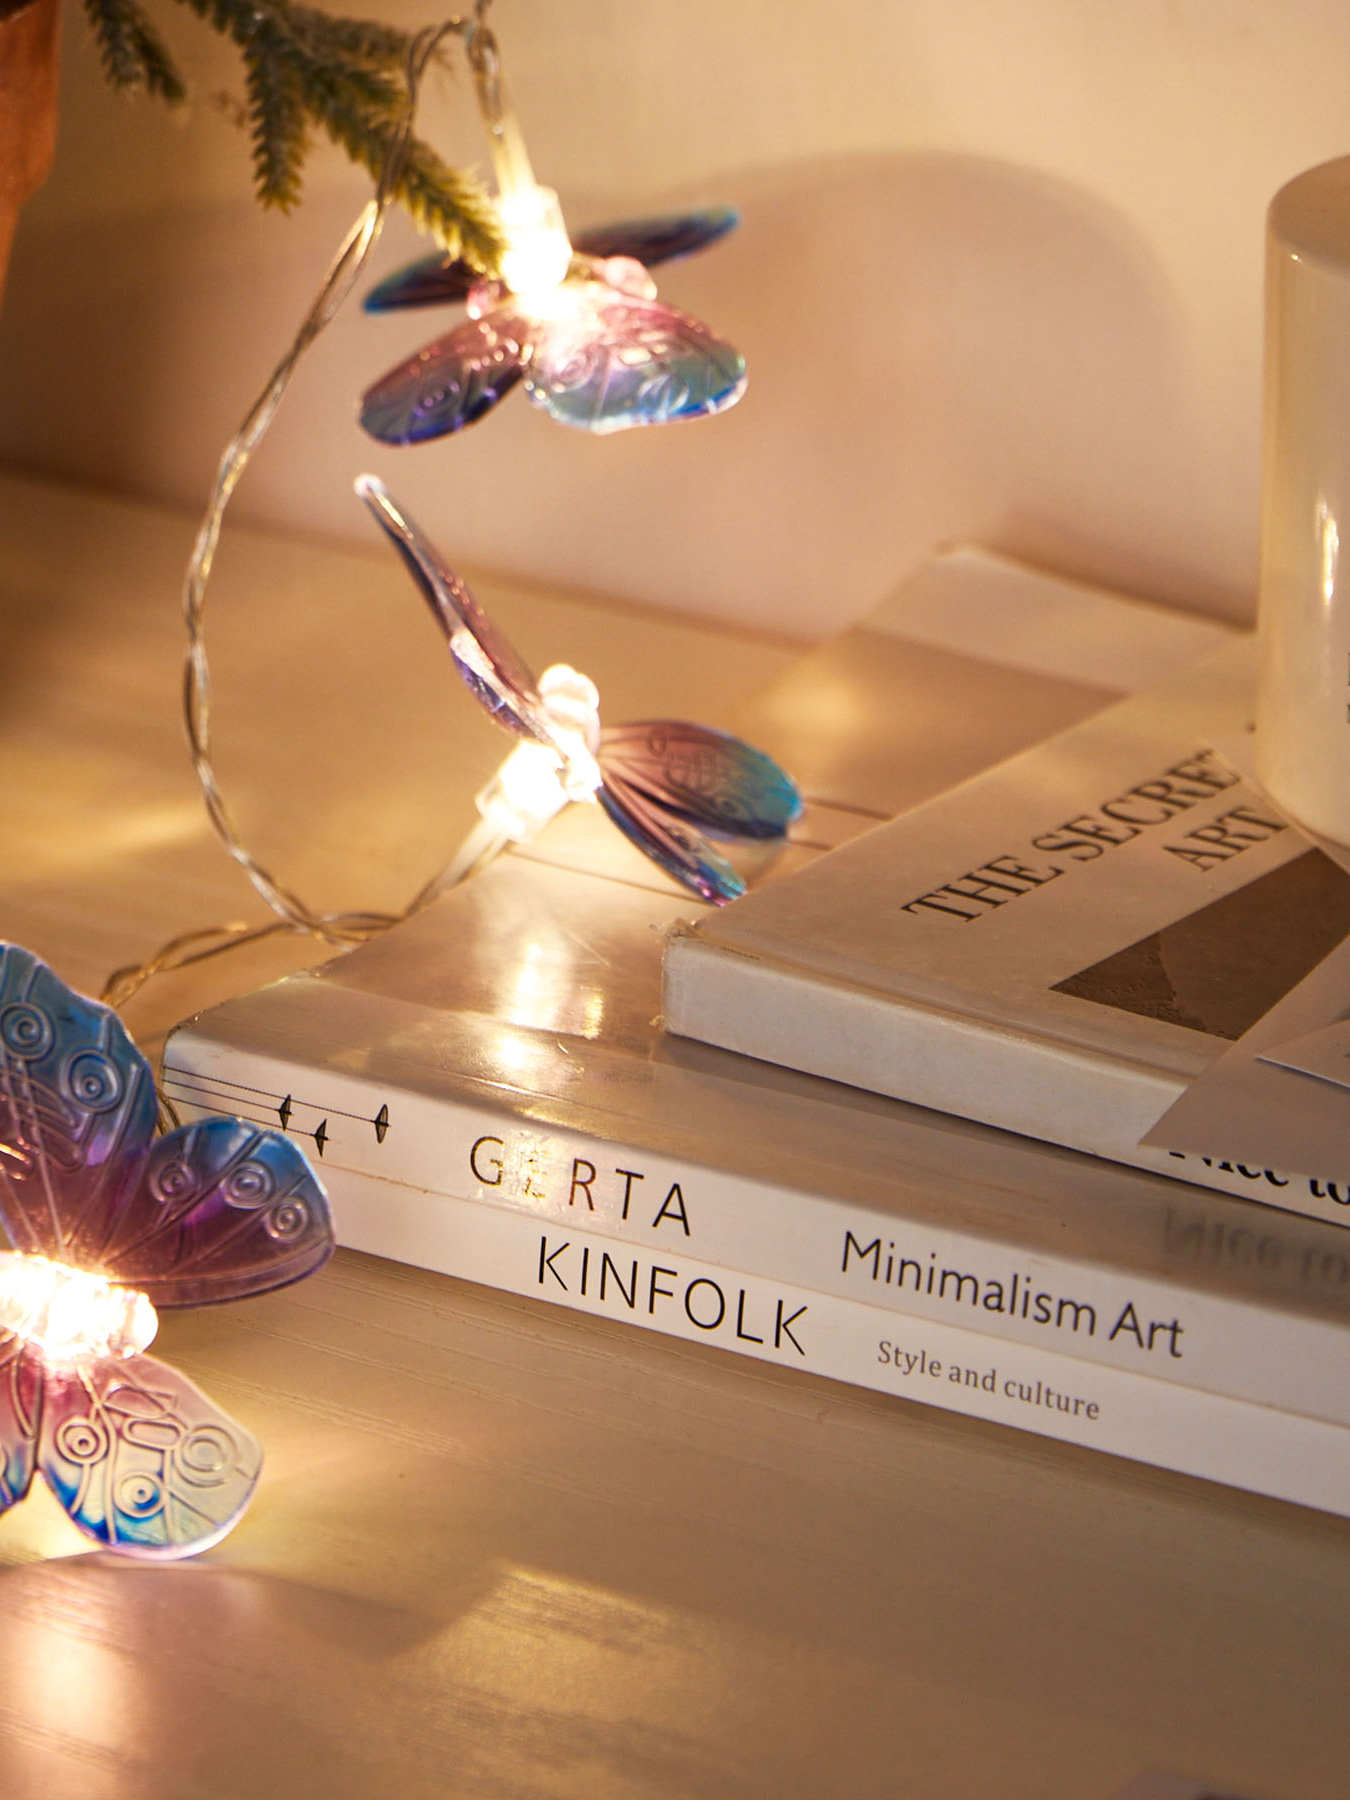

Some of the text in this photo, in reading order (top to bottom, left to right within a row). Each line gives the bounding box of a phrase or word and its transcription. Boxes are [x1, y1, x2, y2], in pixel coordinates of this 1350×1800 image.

[901, 748, 1241, 923] THE SECRE
[1163, 806, 1289, 872] ART
[538, 1236, 808, 1356] KINFOLK
[841, 1230, 1097, 1337] Minimalism
[1109, 1302, 1185, 1358] Art
[878, 1341, 1101, 1421] Style and culture
